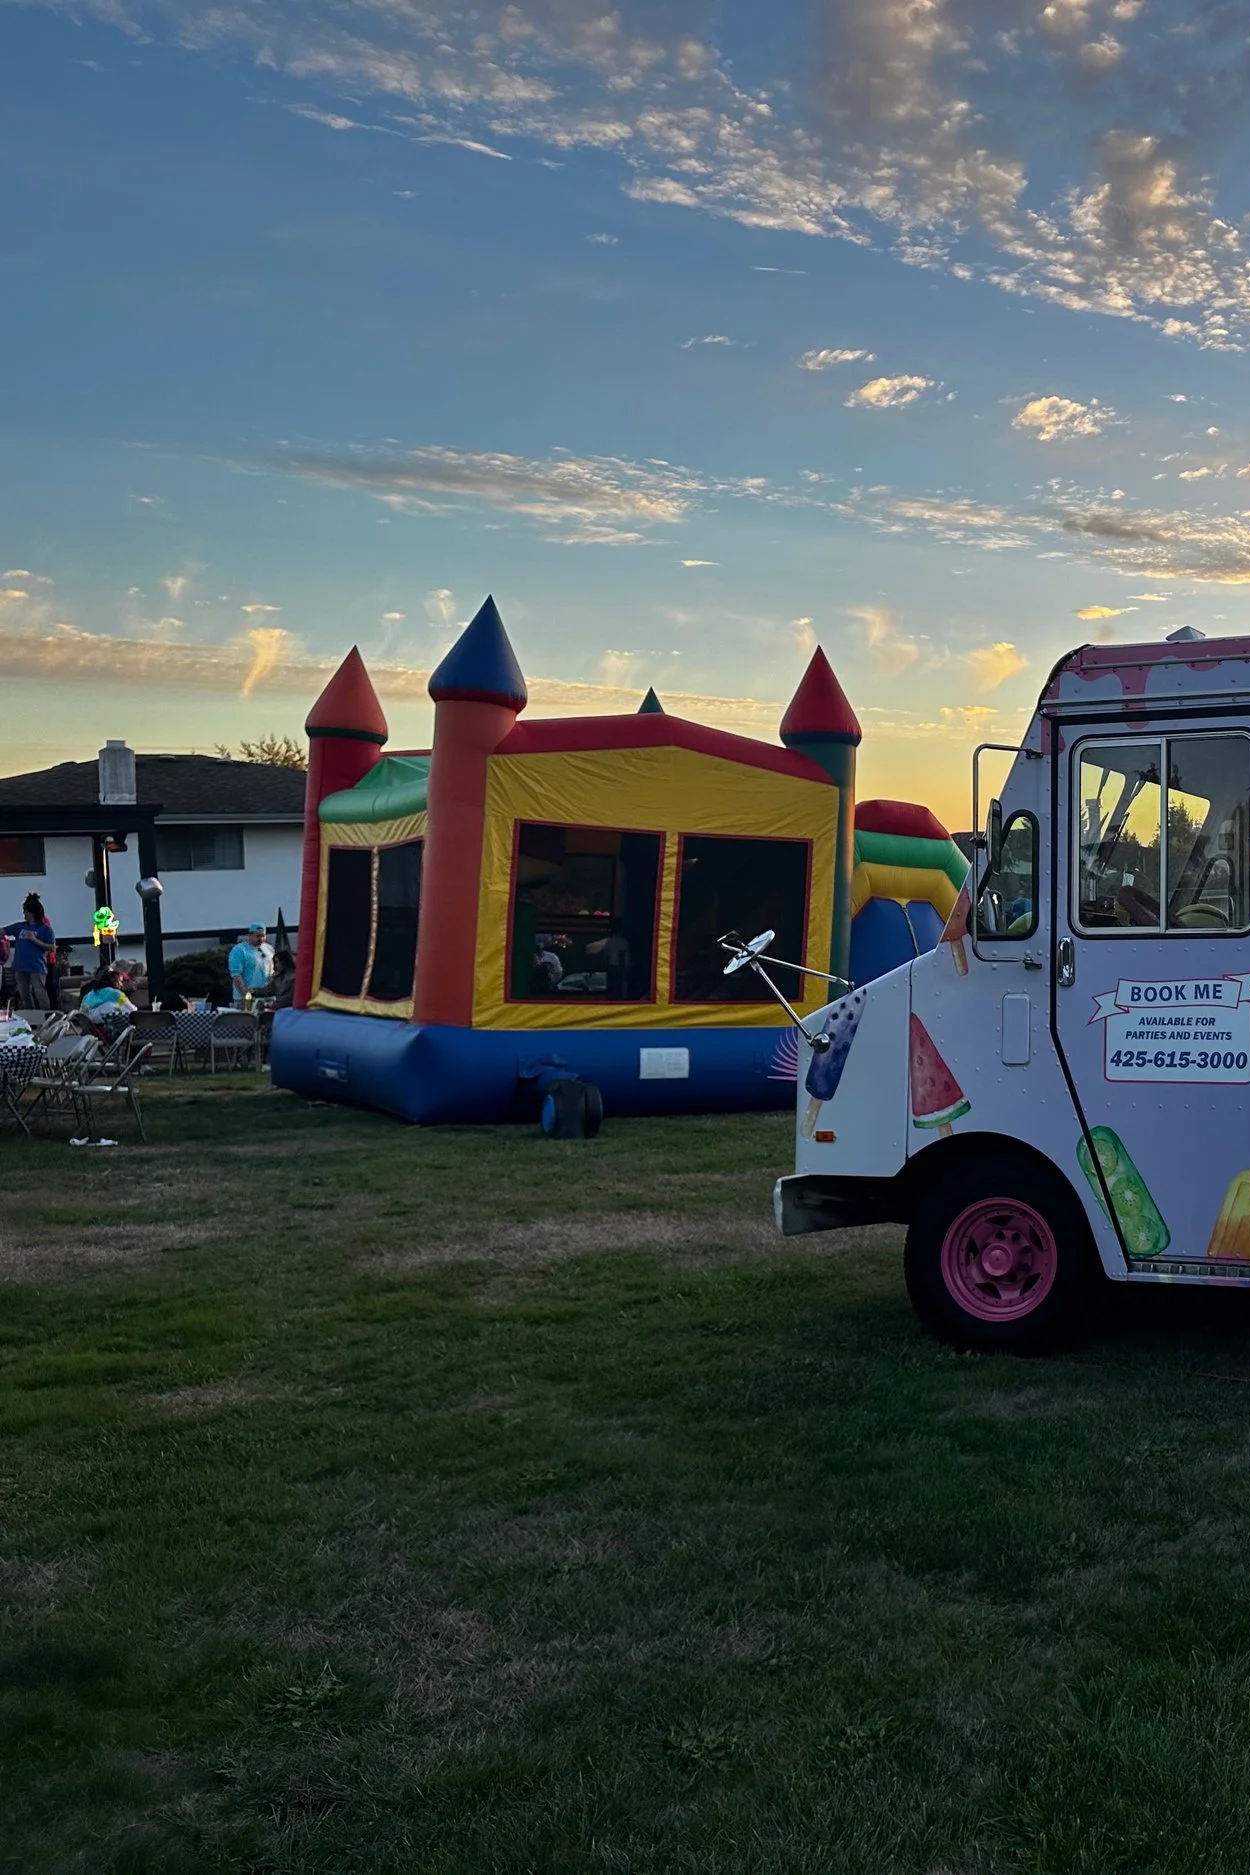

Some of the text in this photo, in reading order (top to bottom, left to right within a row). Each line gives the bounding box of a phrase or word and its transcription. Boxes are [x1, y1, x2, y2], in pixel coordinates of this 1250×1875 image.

[1130, 983, 1222, 1002] BOOK ME
[1138, 1017, 1216, 1026] AVAILABLE FOR
[1125, 1031, 1233, 1041] PARTIES AND EVENTS
[1110, 1050, 1248, 1069] 425-615-3000
